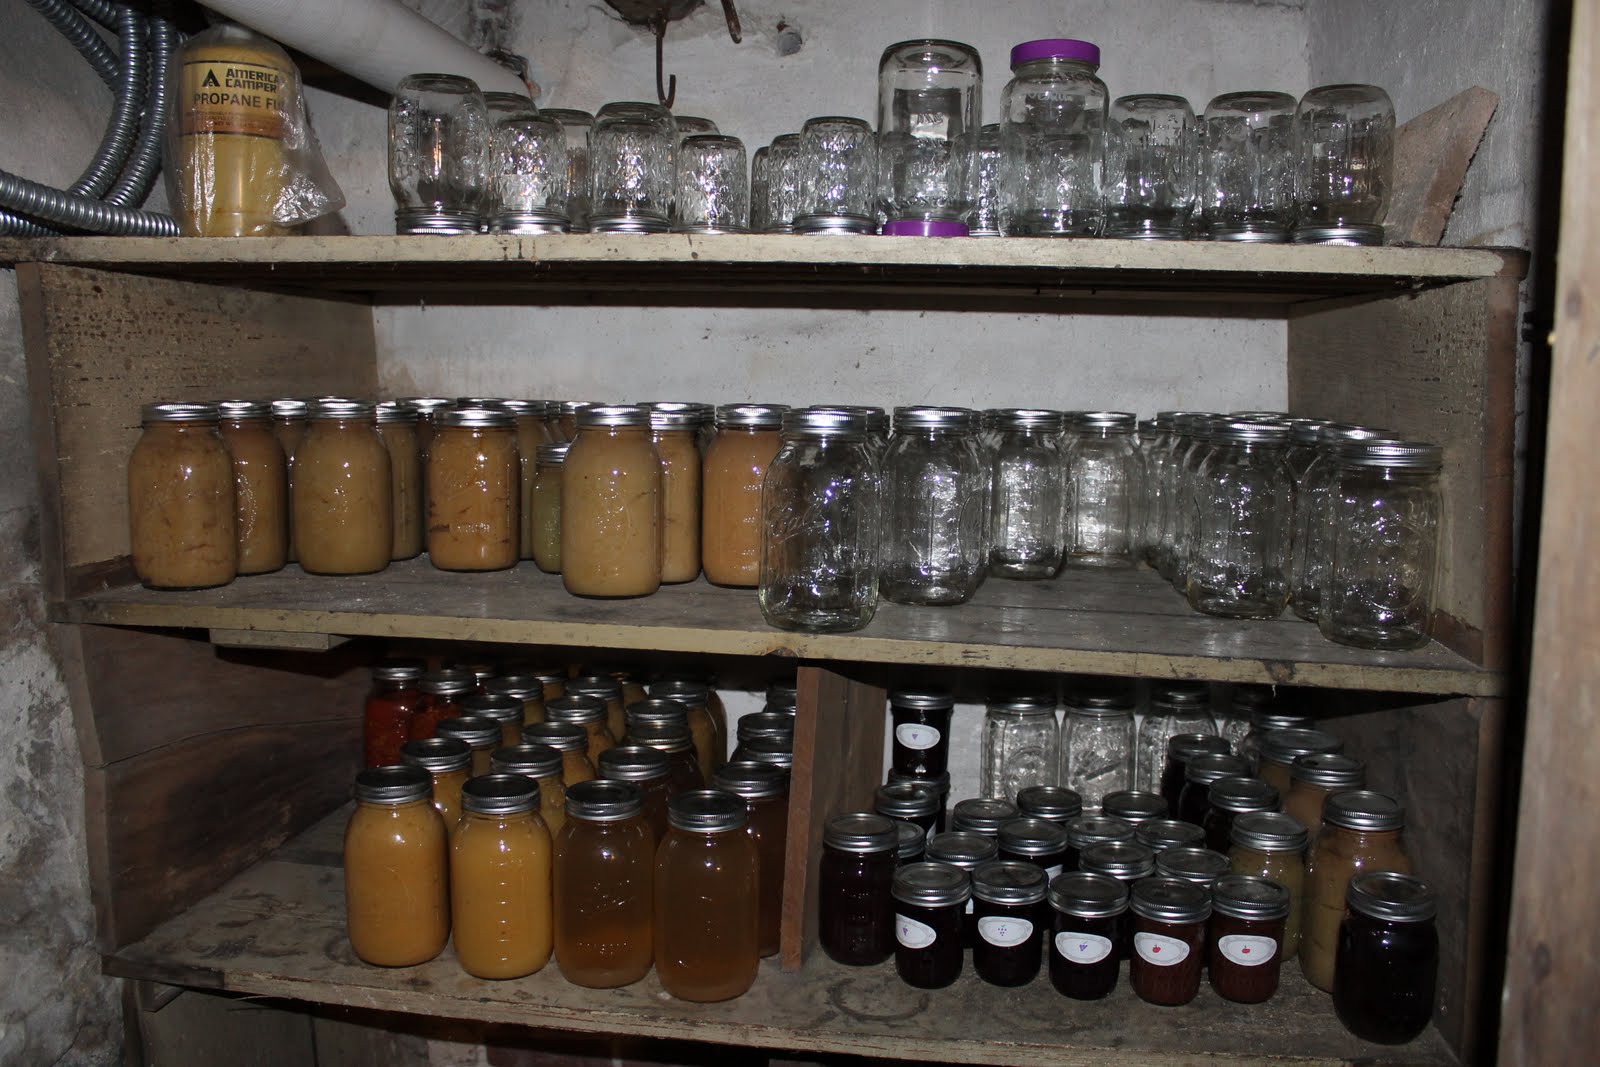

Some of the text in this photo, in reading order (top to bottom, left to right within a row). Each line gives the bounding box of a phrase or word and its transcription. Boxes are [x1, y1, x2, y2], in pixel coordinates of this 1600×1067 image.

[226, 68, 280, 84] AMERICA
[225, 78, 277, 94] CAMPER
[194, 93, 261, 108] PROPANE
